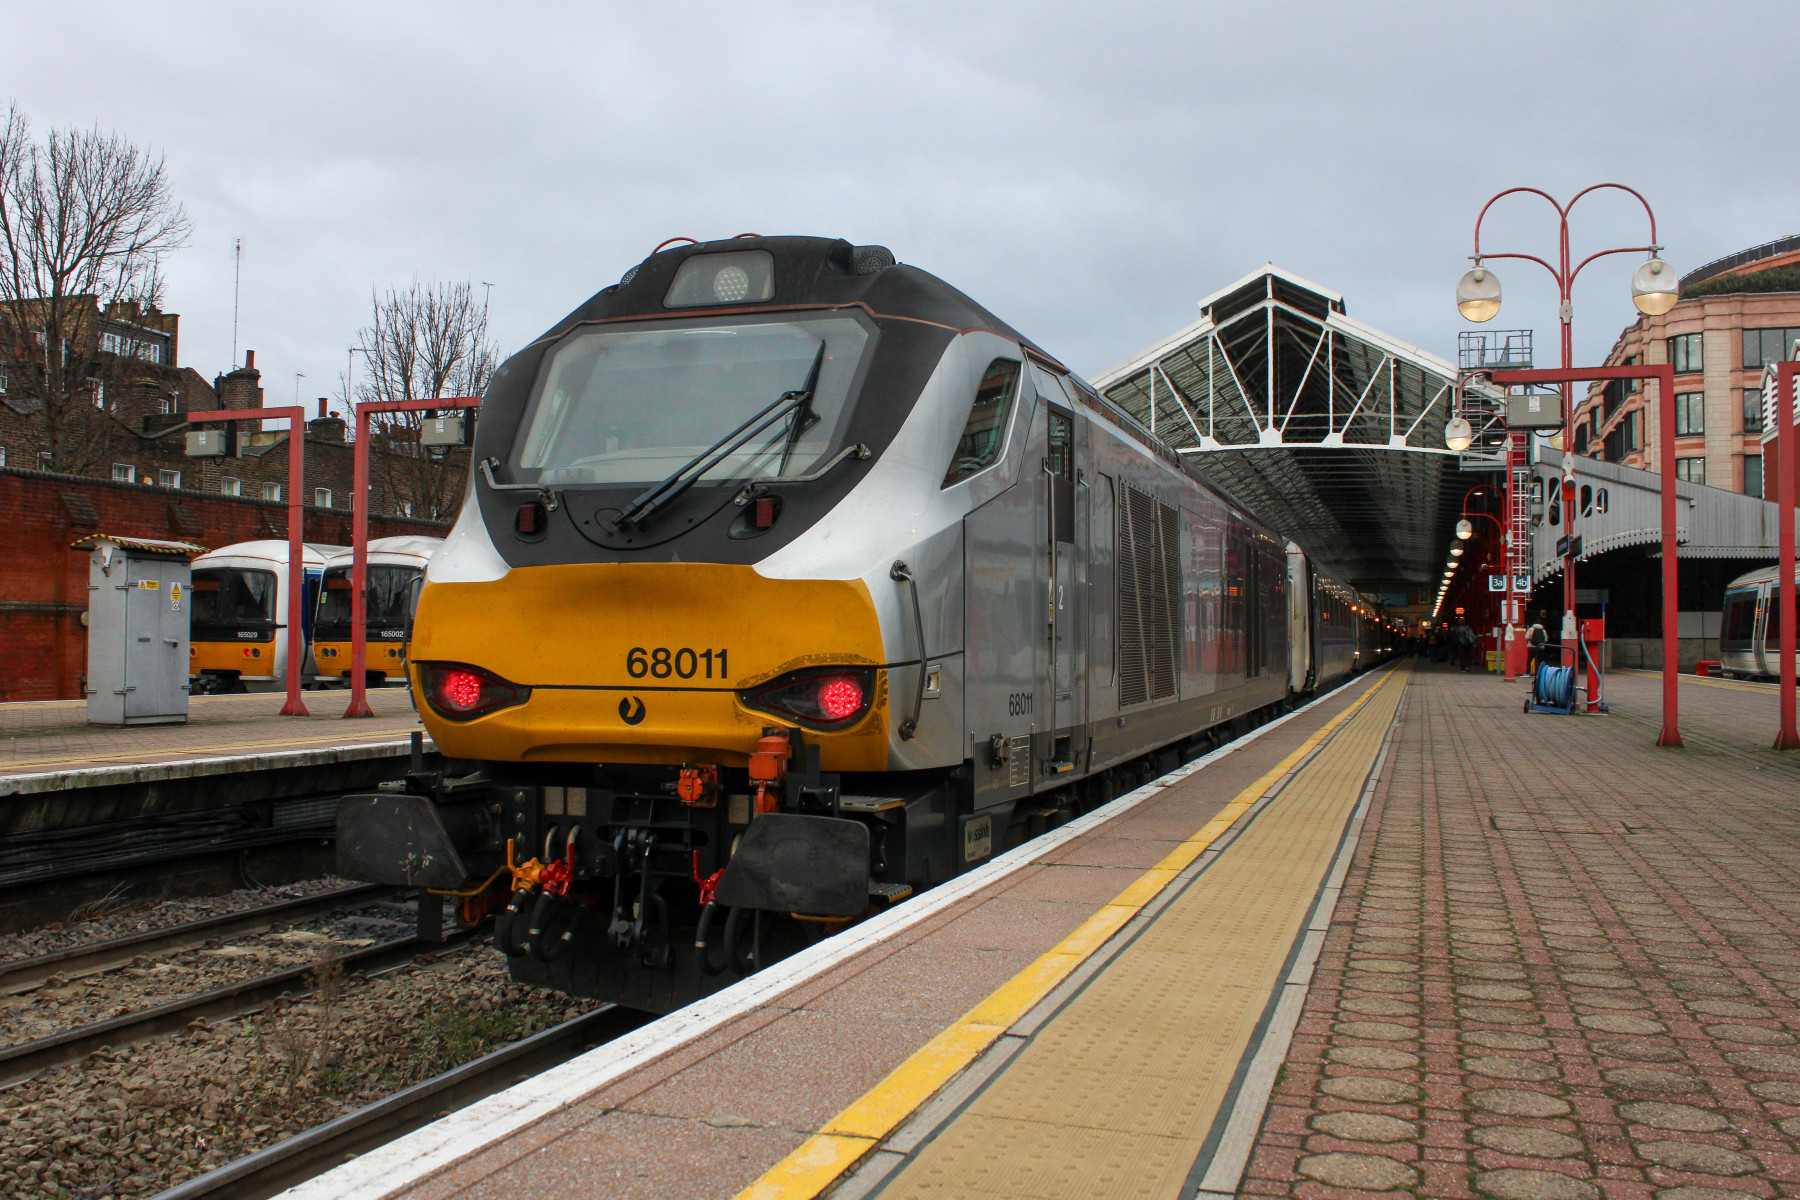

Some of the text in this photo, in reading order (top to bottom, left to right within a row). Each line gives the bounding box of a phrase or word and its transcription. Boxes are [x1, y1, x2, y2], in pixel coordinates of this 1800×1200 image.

[1493, 578, 1503, 587] 3a
[1517, 578, 1527, 587] 4b
[1058, 584, 1064, 610] 2
[381, 630, 404, 638] 165002
[626, 646, 728, 679] 68011
[1008, 692, 1033, 717] 68011
